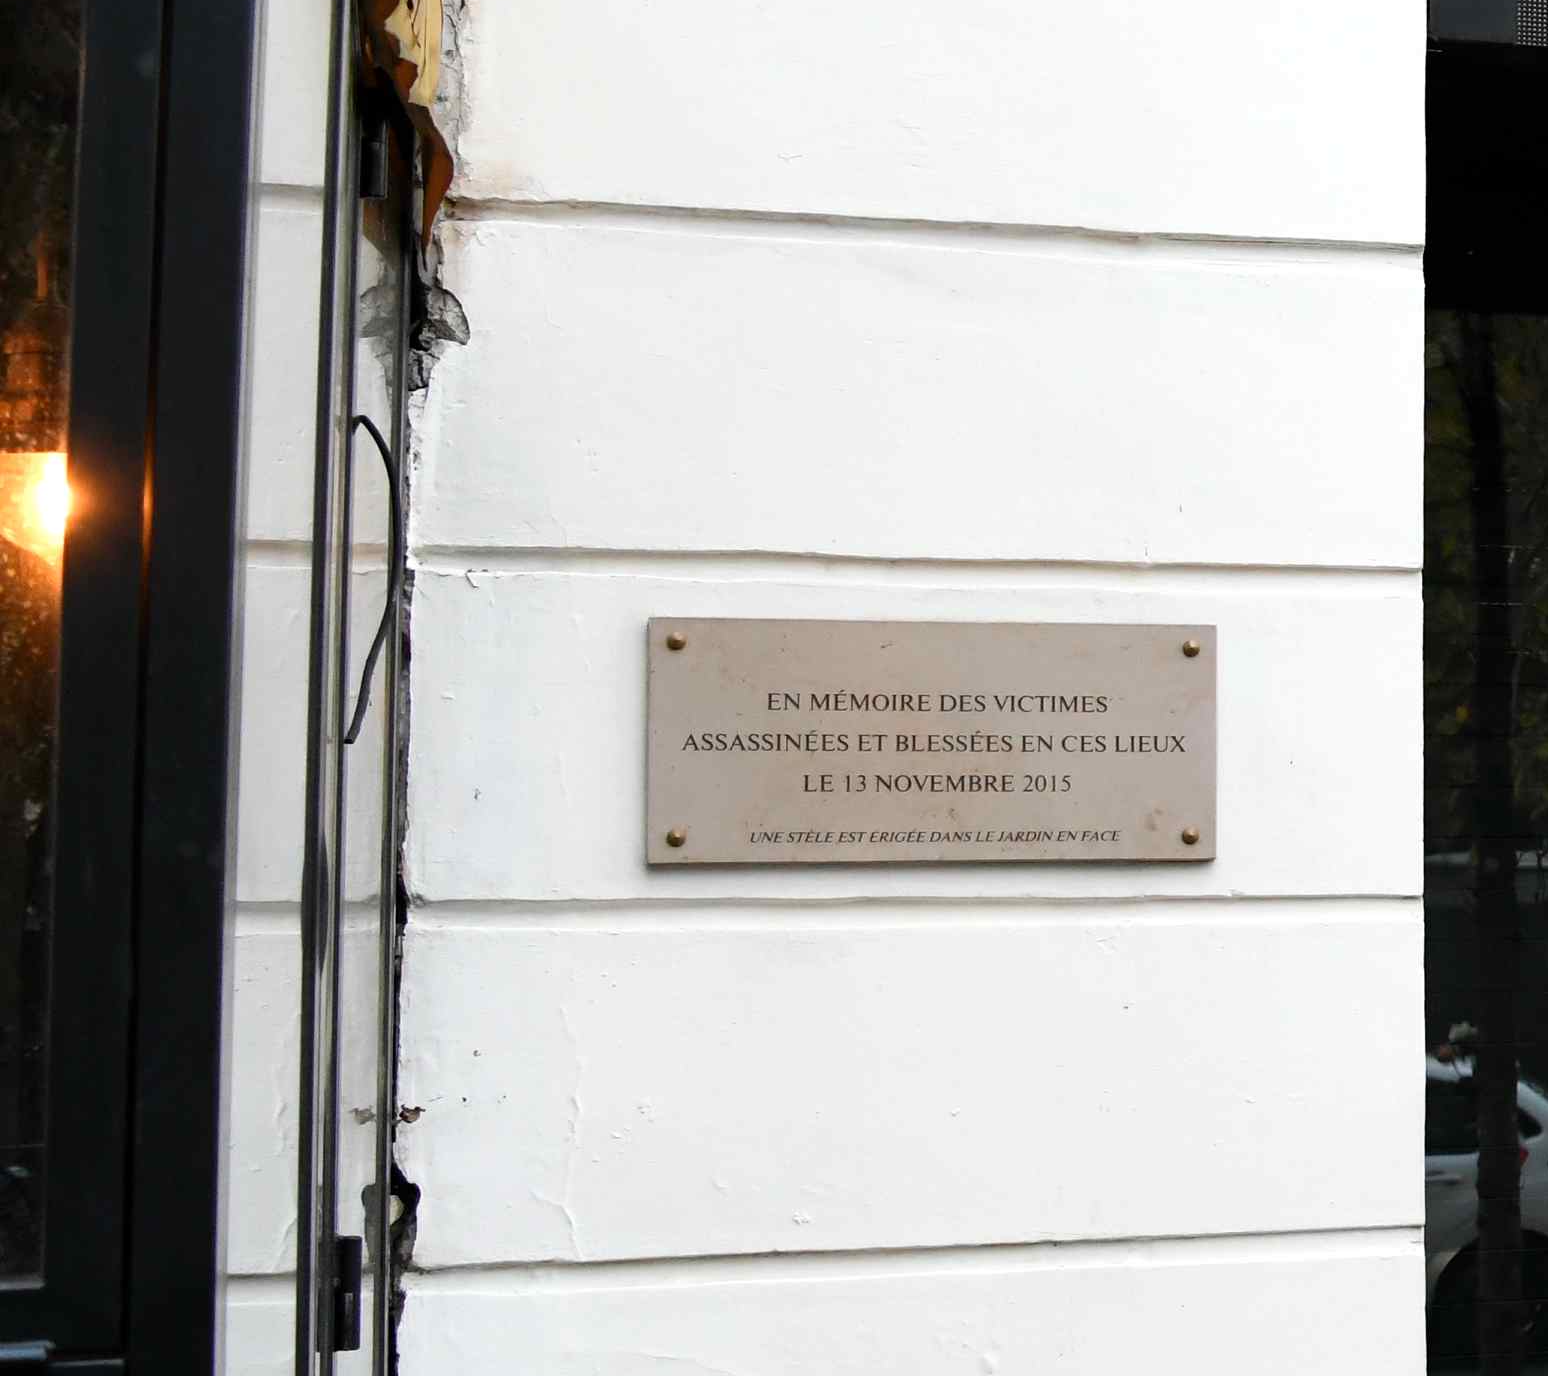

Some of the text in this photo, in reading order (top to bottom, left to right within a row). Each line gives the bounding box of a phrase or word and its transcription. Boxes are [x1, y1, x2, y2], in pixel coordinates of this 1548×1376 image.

[767, 687, 1109, 714] EN MÉMOIRE DES VICTIMES
[682, 728, 1186, 753] ASSASSINÉES ET BLESSÉES EN CES LIEUX
[803, 774, 1072, 793] LE 13 NOVEMBRE 2015
[749, 830, 784, 842] UNE
[837, 830, 868, 842] EST
[928, 830, 973, 842] DANS
[975, 830, 995, 842] LE
[997, 830, 1054, 843] JARDIN
[1056, 830, 1078, 842] EN
[1081, 830, 1121, 842] FACE
